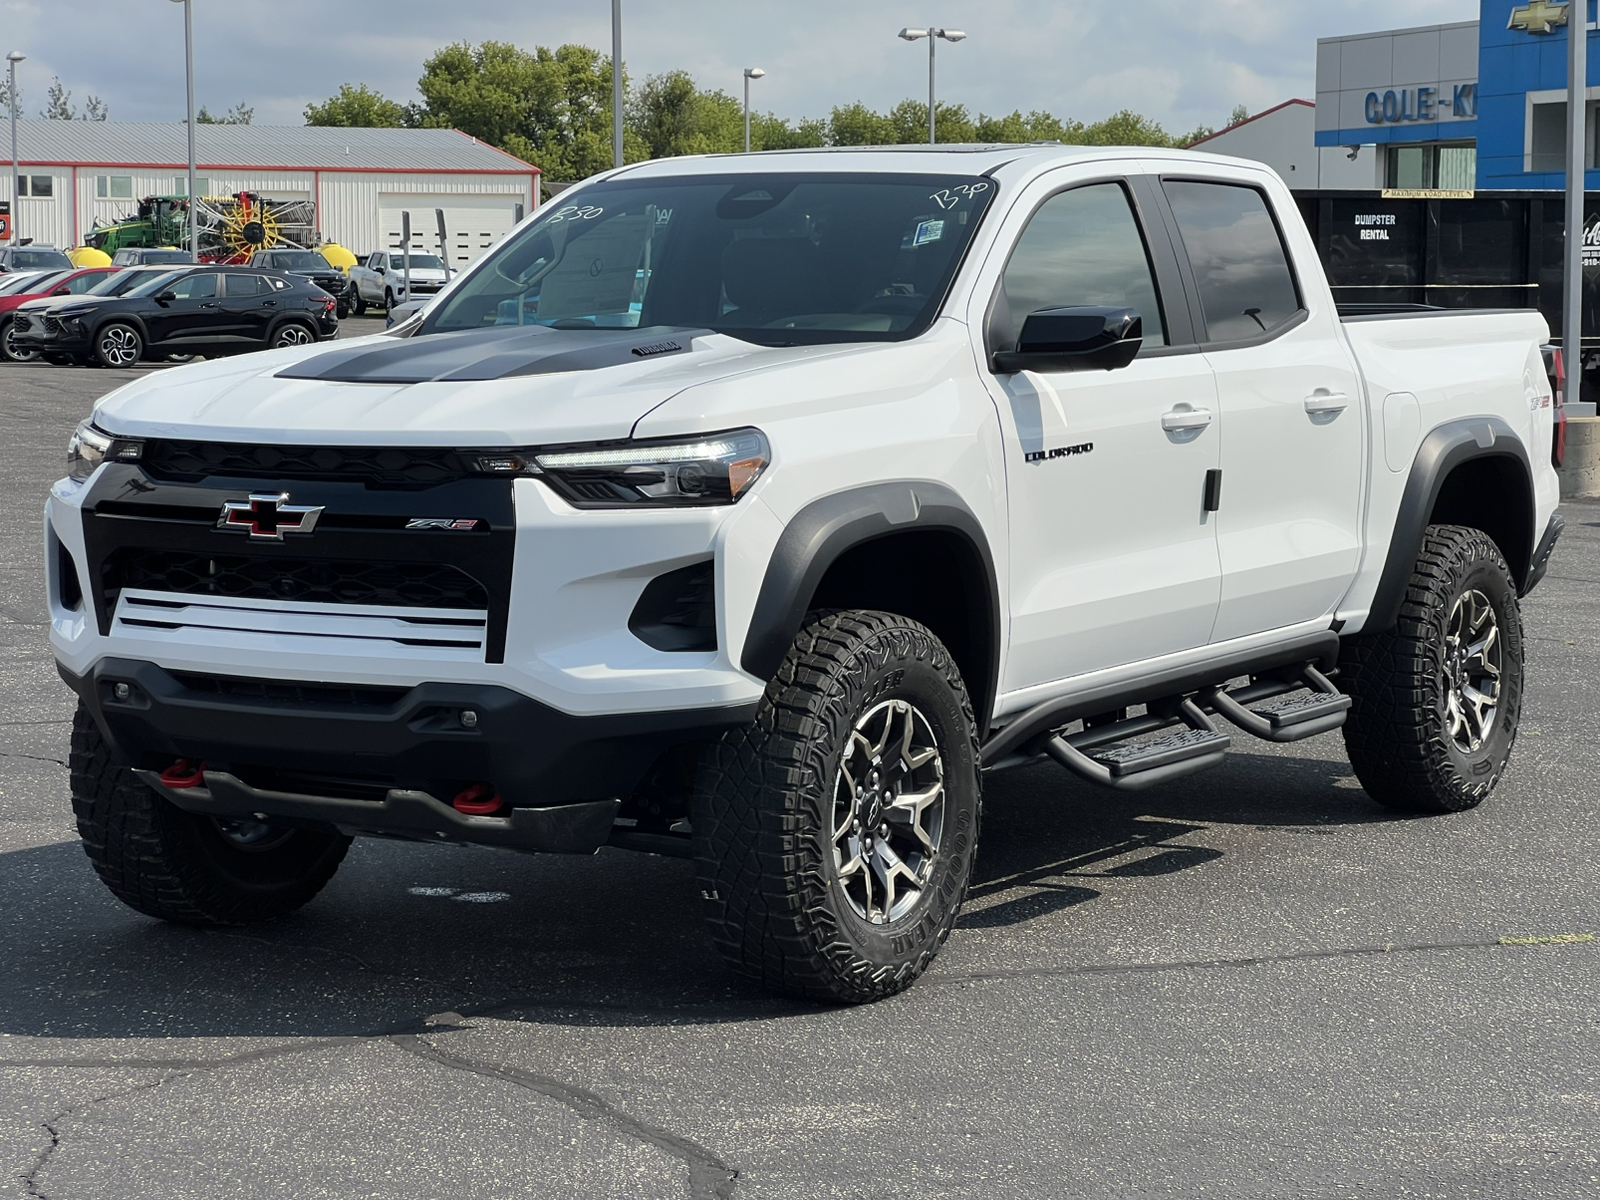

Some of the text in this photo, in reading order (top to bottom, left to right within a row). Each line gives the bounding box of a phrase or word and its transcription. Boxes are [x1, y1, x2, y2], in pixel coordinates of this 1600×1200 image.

[1391, 189, 1465, 197] MAXIMUM LOAD LEVEL
[1354, 214, 1396, 225] DUMPSTER
[1360, 229, 1390, 240] RENTAL
[1530, 395, 1550, 411] ZR2
[1025, 442, 1094, 463] COLORADO
[404, 518, 478, 531] ZR2
